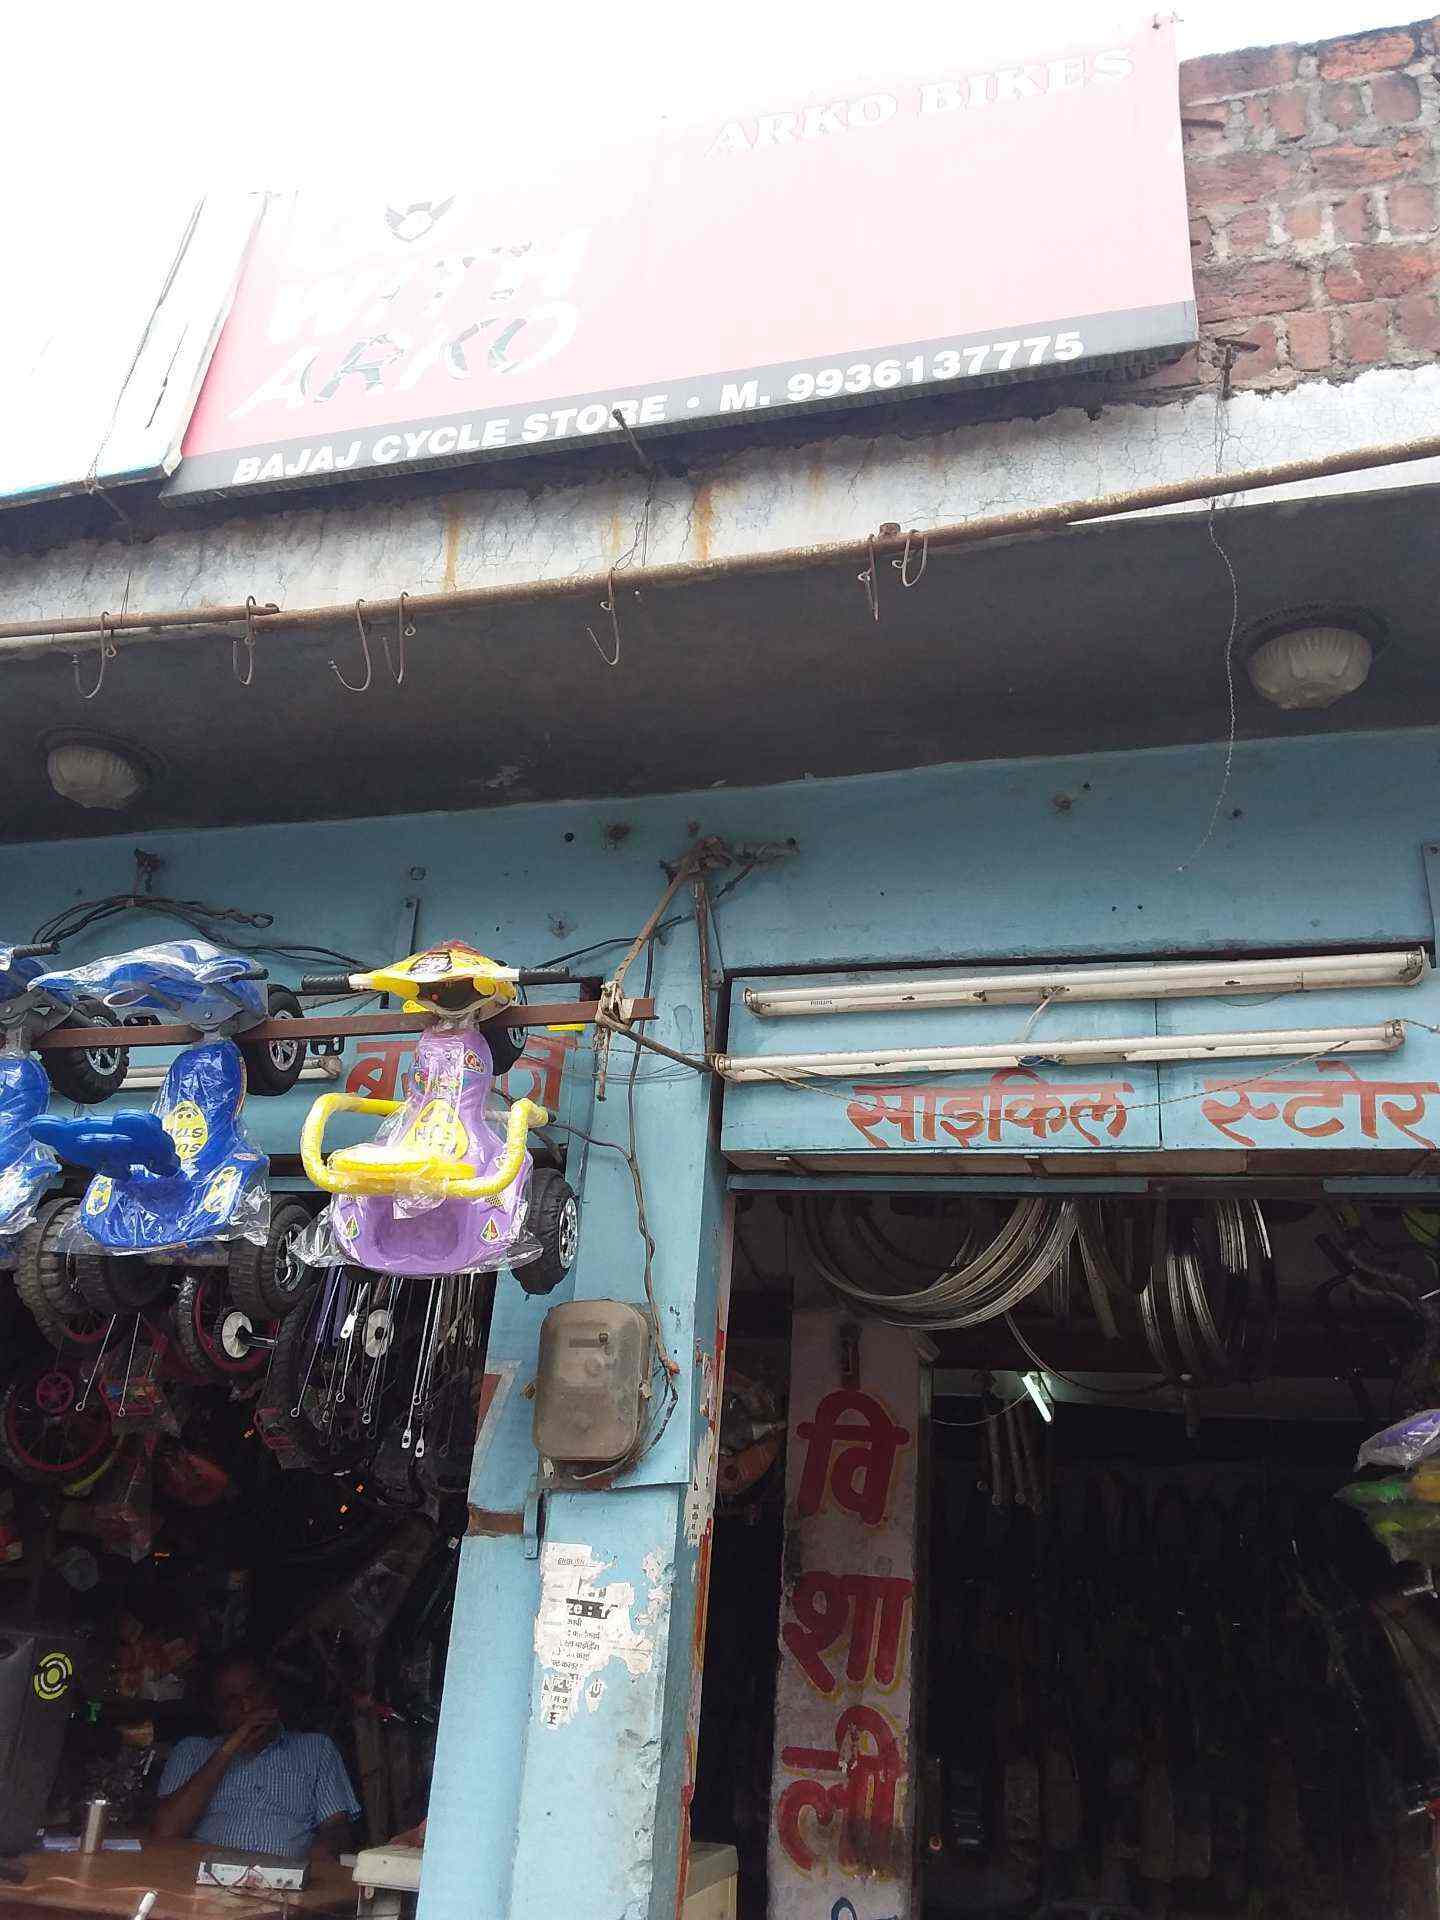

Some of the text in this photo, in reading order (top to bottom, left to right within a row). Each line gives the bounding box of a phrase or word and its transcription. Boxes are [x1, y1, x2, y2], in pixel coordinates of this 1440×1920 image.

[703, 48, 1136, 159] ARKO BIKES
[231, 331, 1085, 486] BAJAJ CYCLE STORE M. 9936137775
[847, 1066, 1135, 1149] साइकिल
[1201, 1060, 1439, 1150] स्टोर
